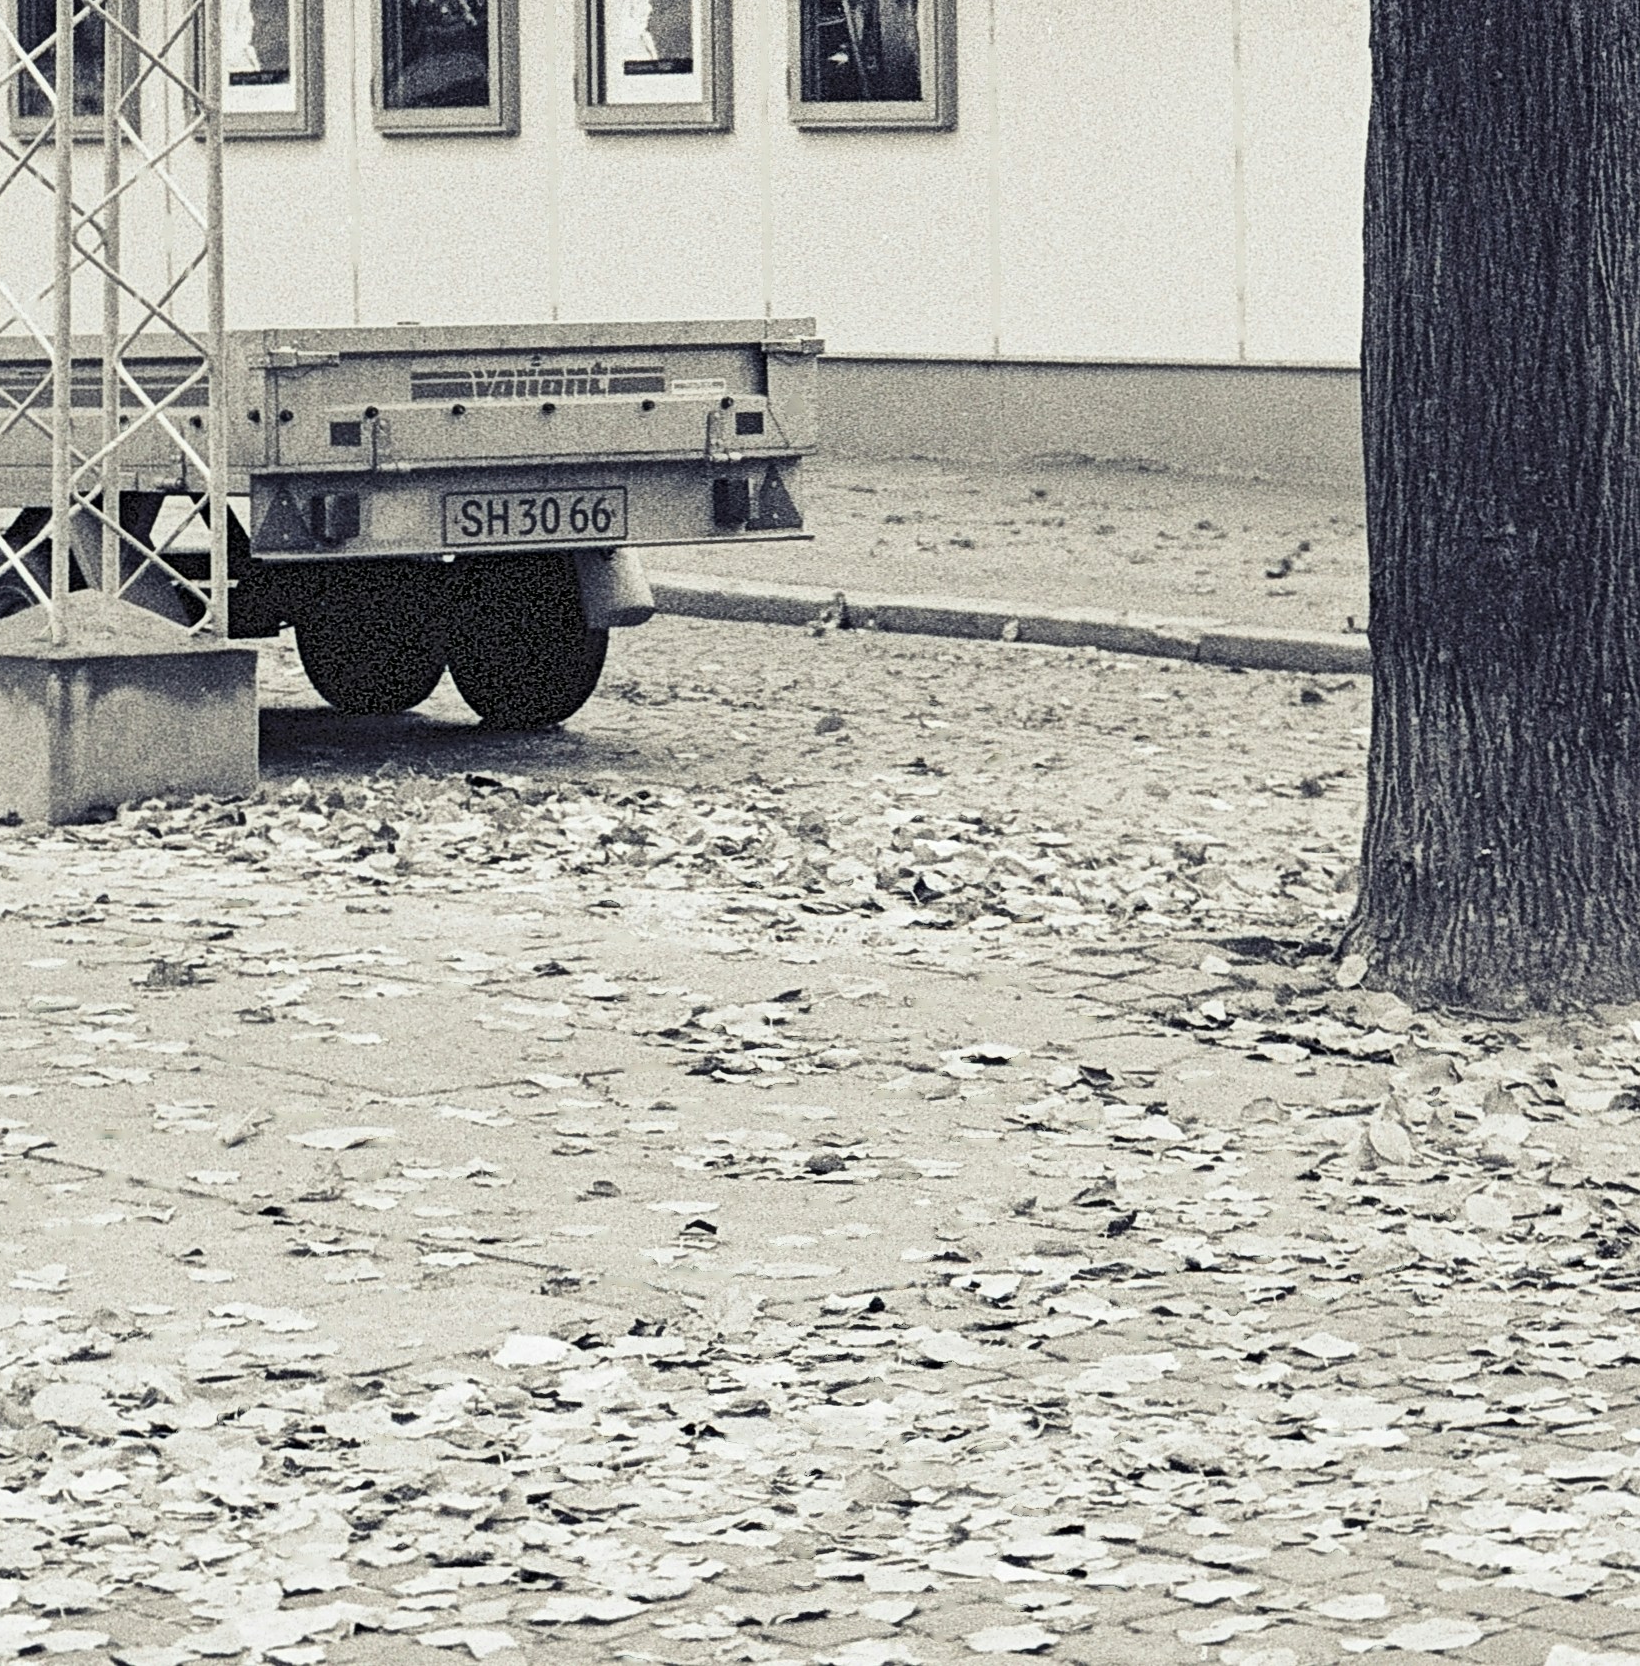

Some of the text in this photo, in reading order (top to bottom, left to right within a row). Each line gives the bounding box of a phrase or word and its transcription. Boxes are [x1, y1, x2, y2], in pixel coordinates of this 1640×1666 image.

[460, 495, 612, 538] SH 30 66
